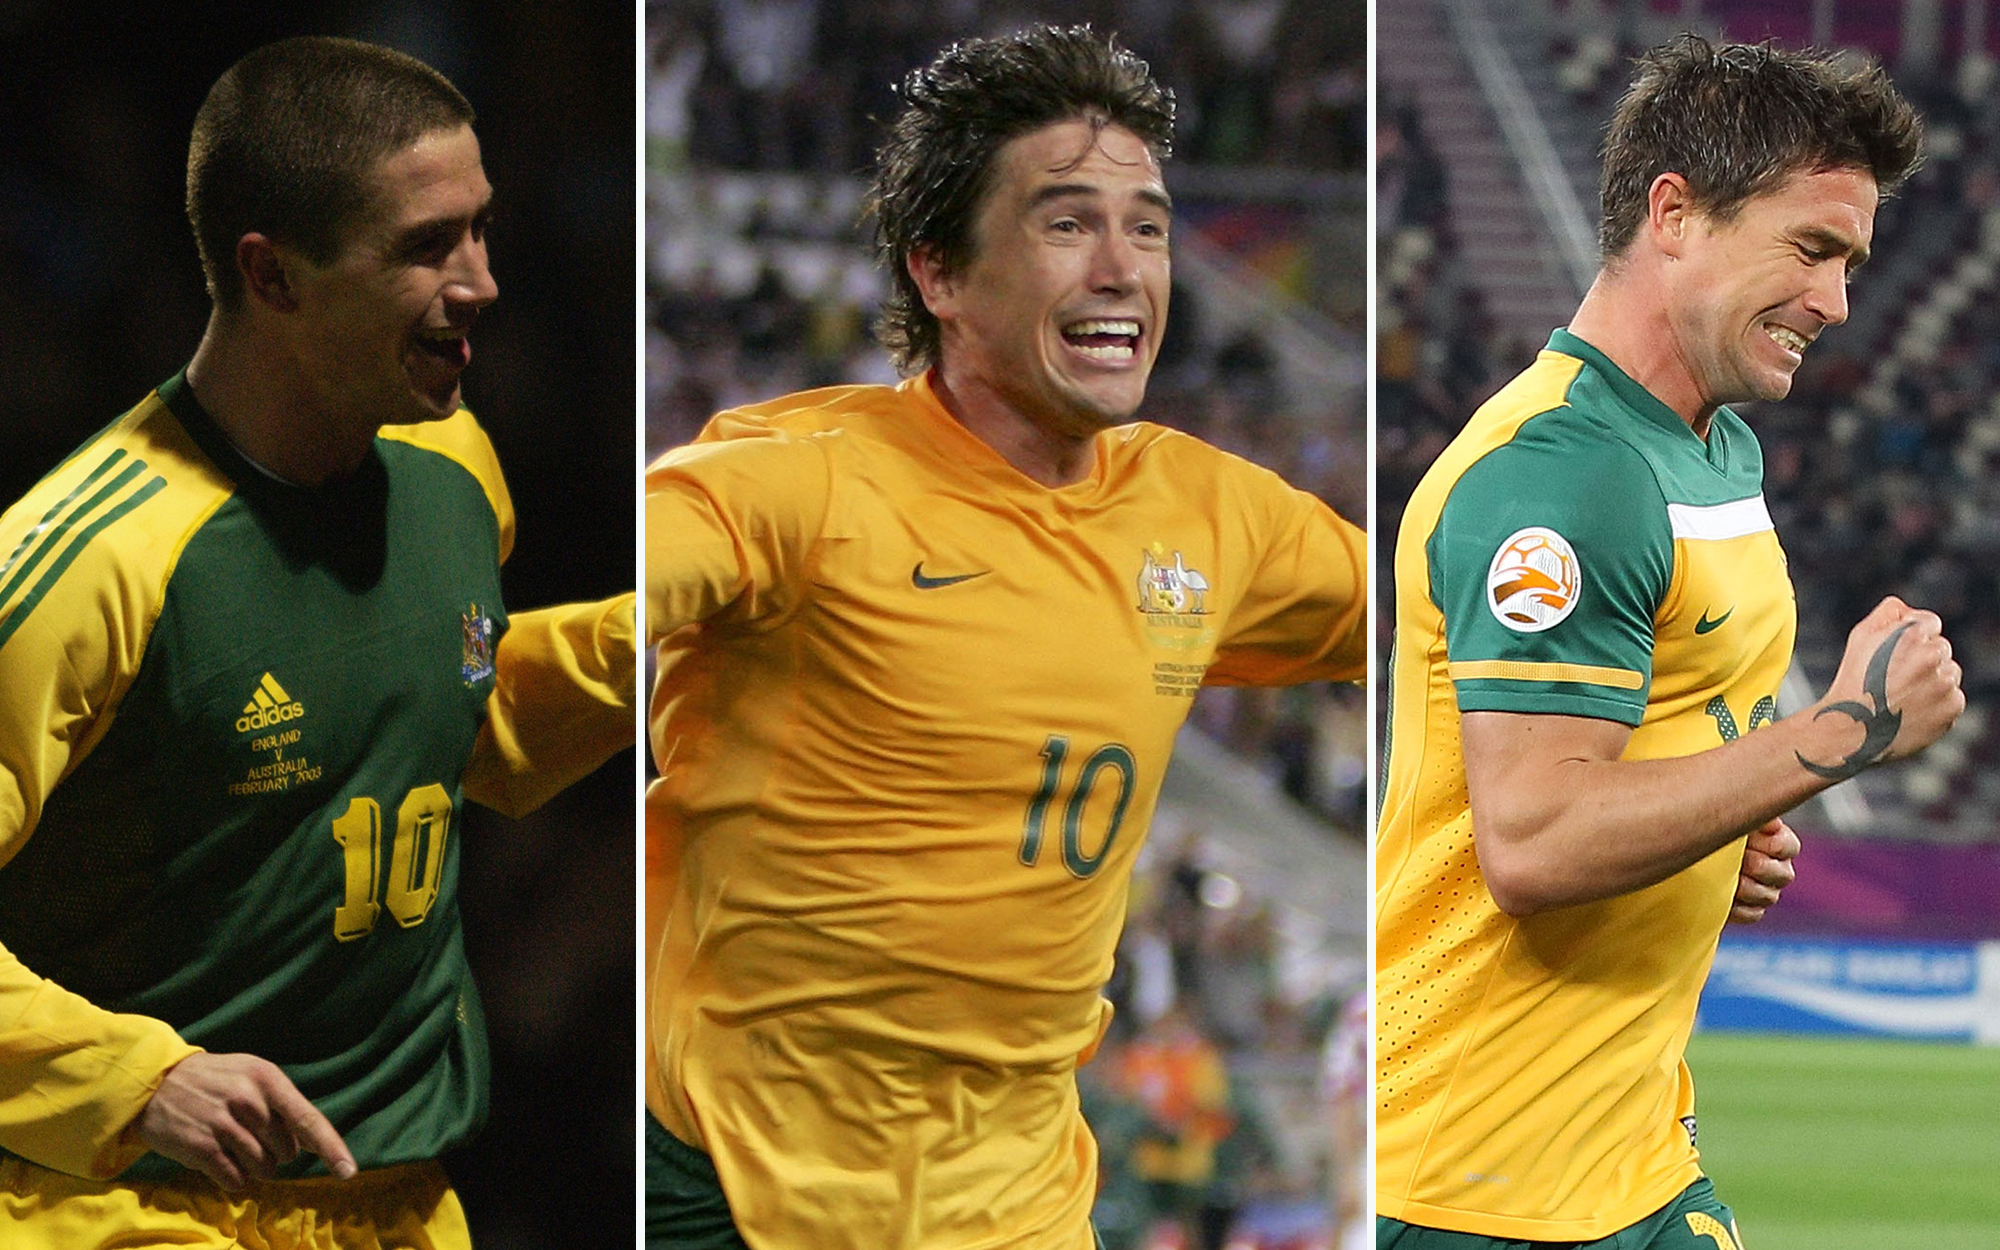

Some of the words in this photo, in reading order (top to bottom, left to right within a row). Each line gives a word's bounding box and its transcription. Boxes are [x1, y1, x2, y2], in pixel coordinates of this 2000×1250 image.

[235, 702, 304, 732] adidas
[252, 729, 301, 752] ENGLAND
[228, 776, 289, 796] FEBRUARY
[296, 766, 321, 785] 2003
[247, 757, 308, 780] AUSTRALIA
[1018, 733, 1137, 880] 10
[332, 782, 453, 943] 10
